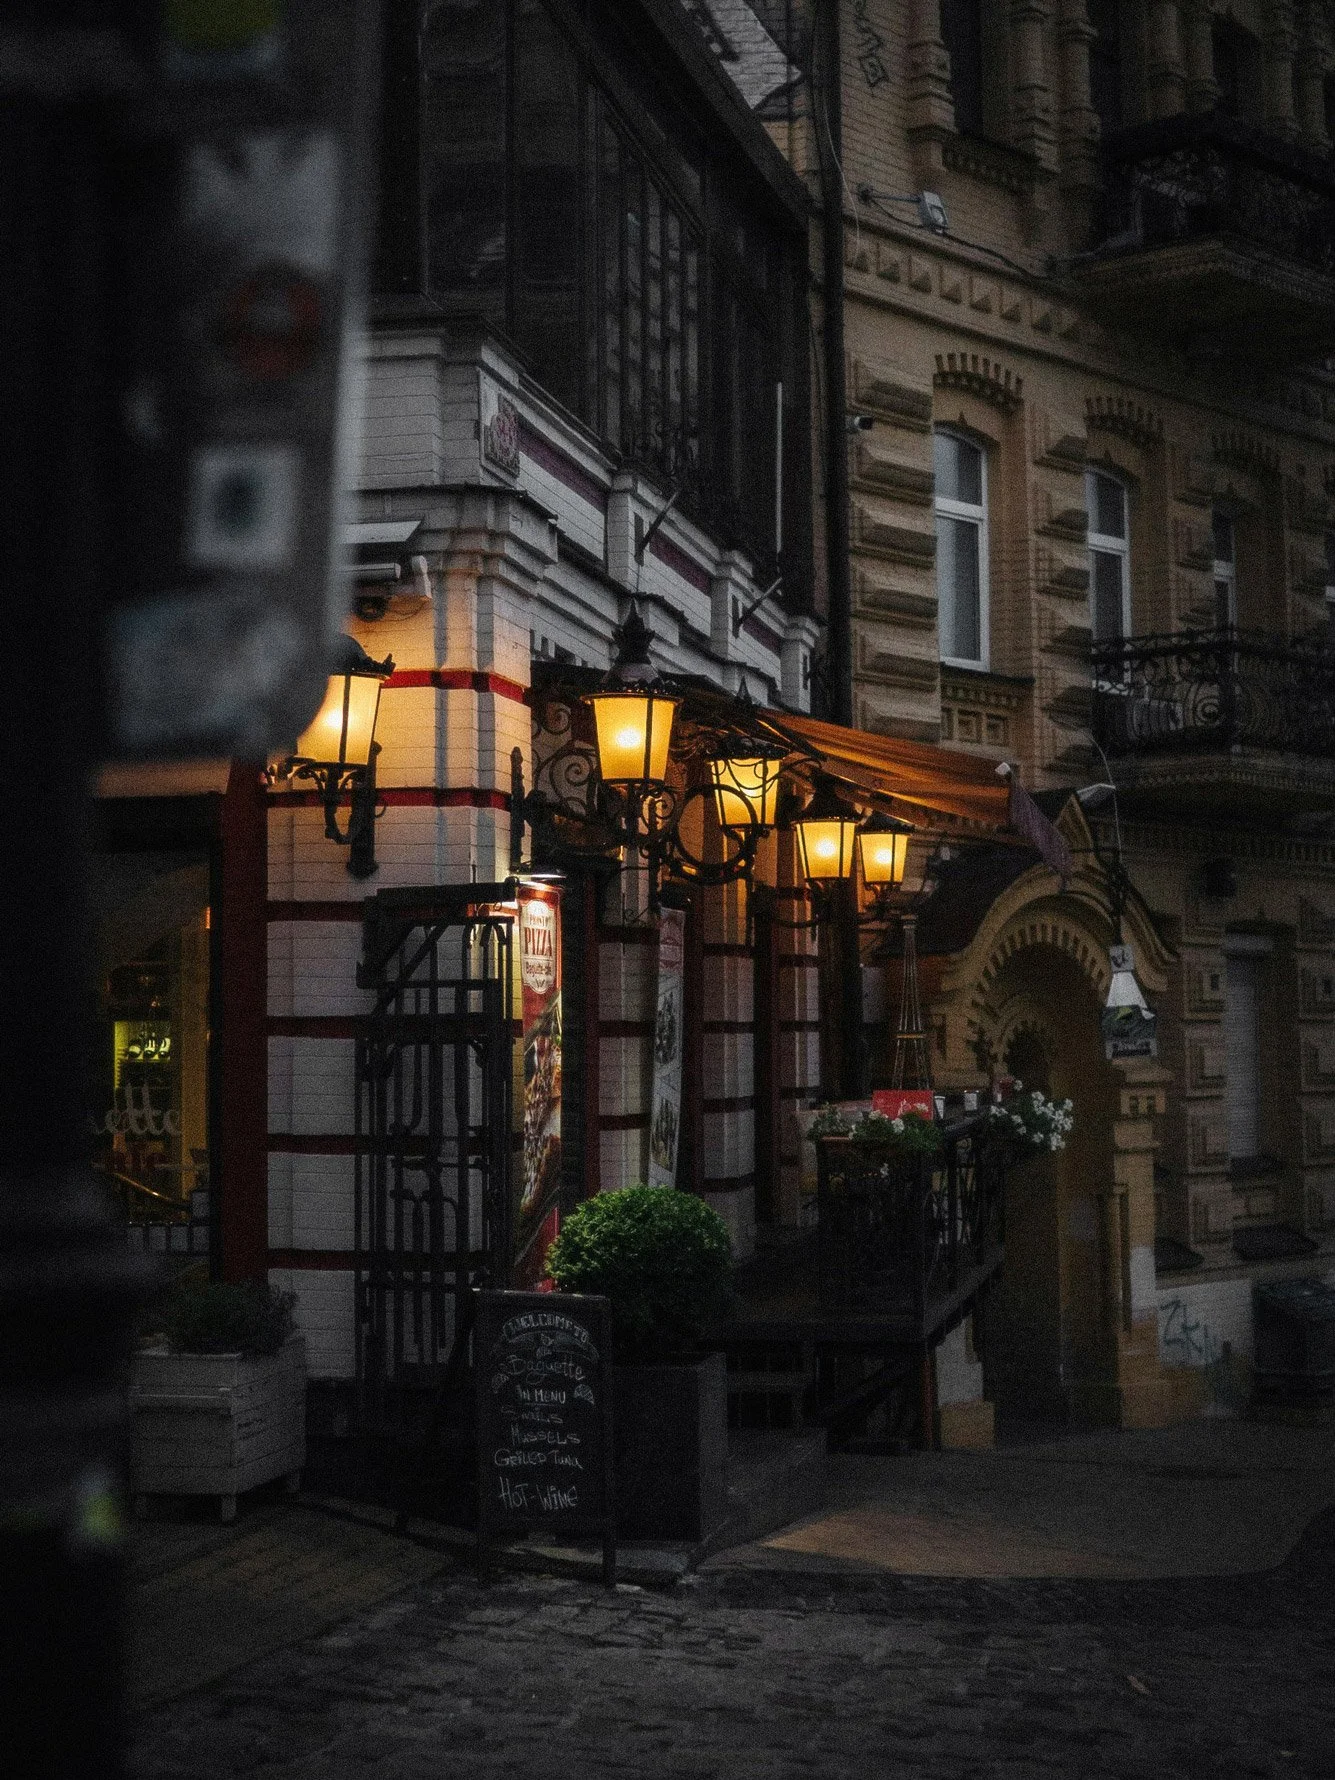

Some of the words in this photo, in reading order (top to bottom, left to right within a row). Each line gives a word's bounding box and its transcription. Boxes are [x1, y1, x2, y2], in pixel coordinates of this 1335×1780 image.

[524, 927, 552, 957] PIZZA
[510, 1313, 573, 1334] WELCOME
[573, 1325, 590, 1343] TO
[500, 1354, 586, 1385] Baguette
